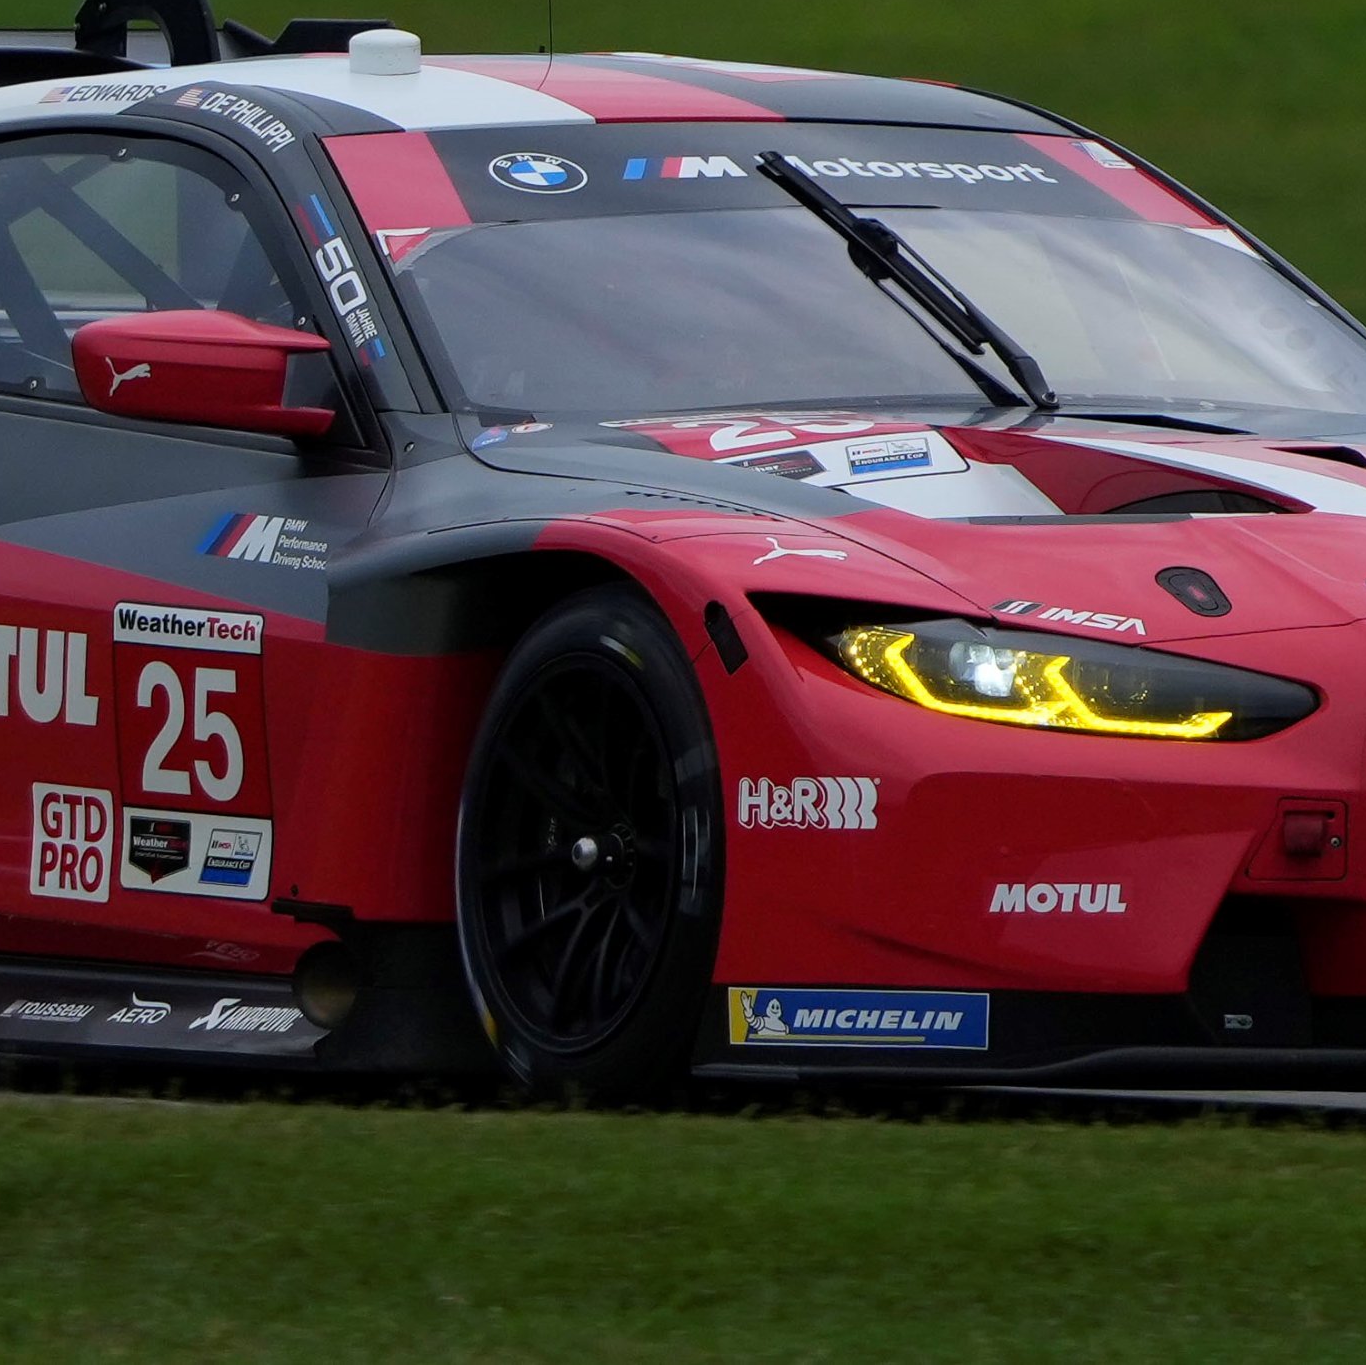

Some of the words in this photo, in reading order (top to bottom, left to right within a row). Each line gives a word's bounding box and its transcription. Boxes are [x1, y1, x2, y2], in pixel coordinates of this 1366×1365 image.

[67, 84, 168, 102] EDWARDS
[200, 92, 236, 114] DE
[226, 97, 297, 154] PHILLIPPI
[315, 236, 368, 316] 50
[356, 308, 378, 340] JAHRE
[284, 518, 308, 532] BMW
[278, 534, 328, 553] Performance
[273, 551, 301, 569] Driving
[301, 555, 327, 570] Schoo
[118, 608, 256, 642] WeatherTech
[1037, 606, 1147, 636] IMSA
[137, 660, 244, 802] 25
[40, 791, 108, 843] GTD
[738, 776, 826, 830] H&R
[38, 841, 104, 894] PRO
[988, 882, 1128, 914] MOTUL
[106, 1006, 169, 1025] AERO
[792, 1008, 965, 1032] MICHELIN
